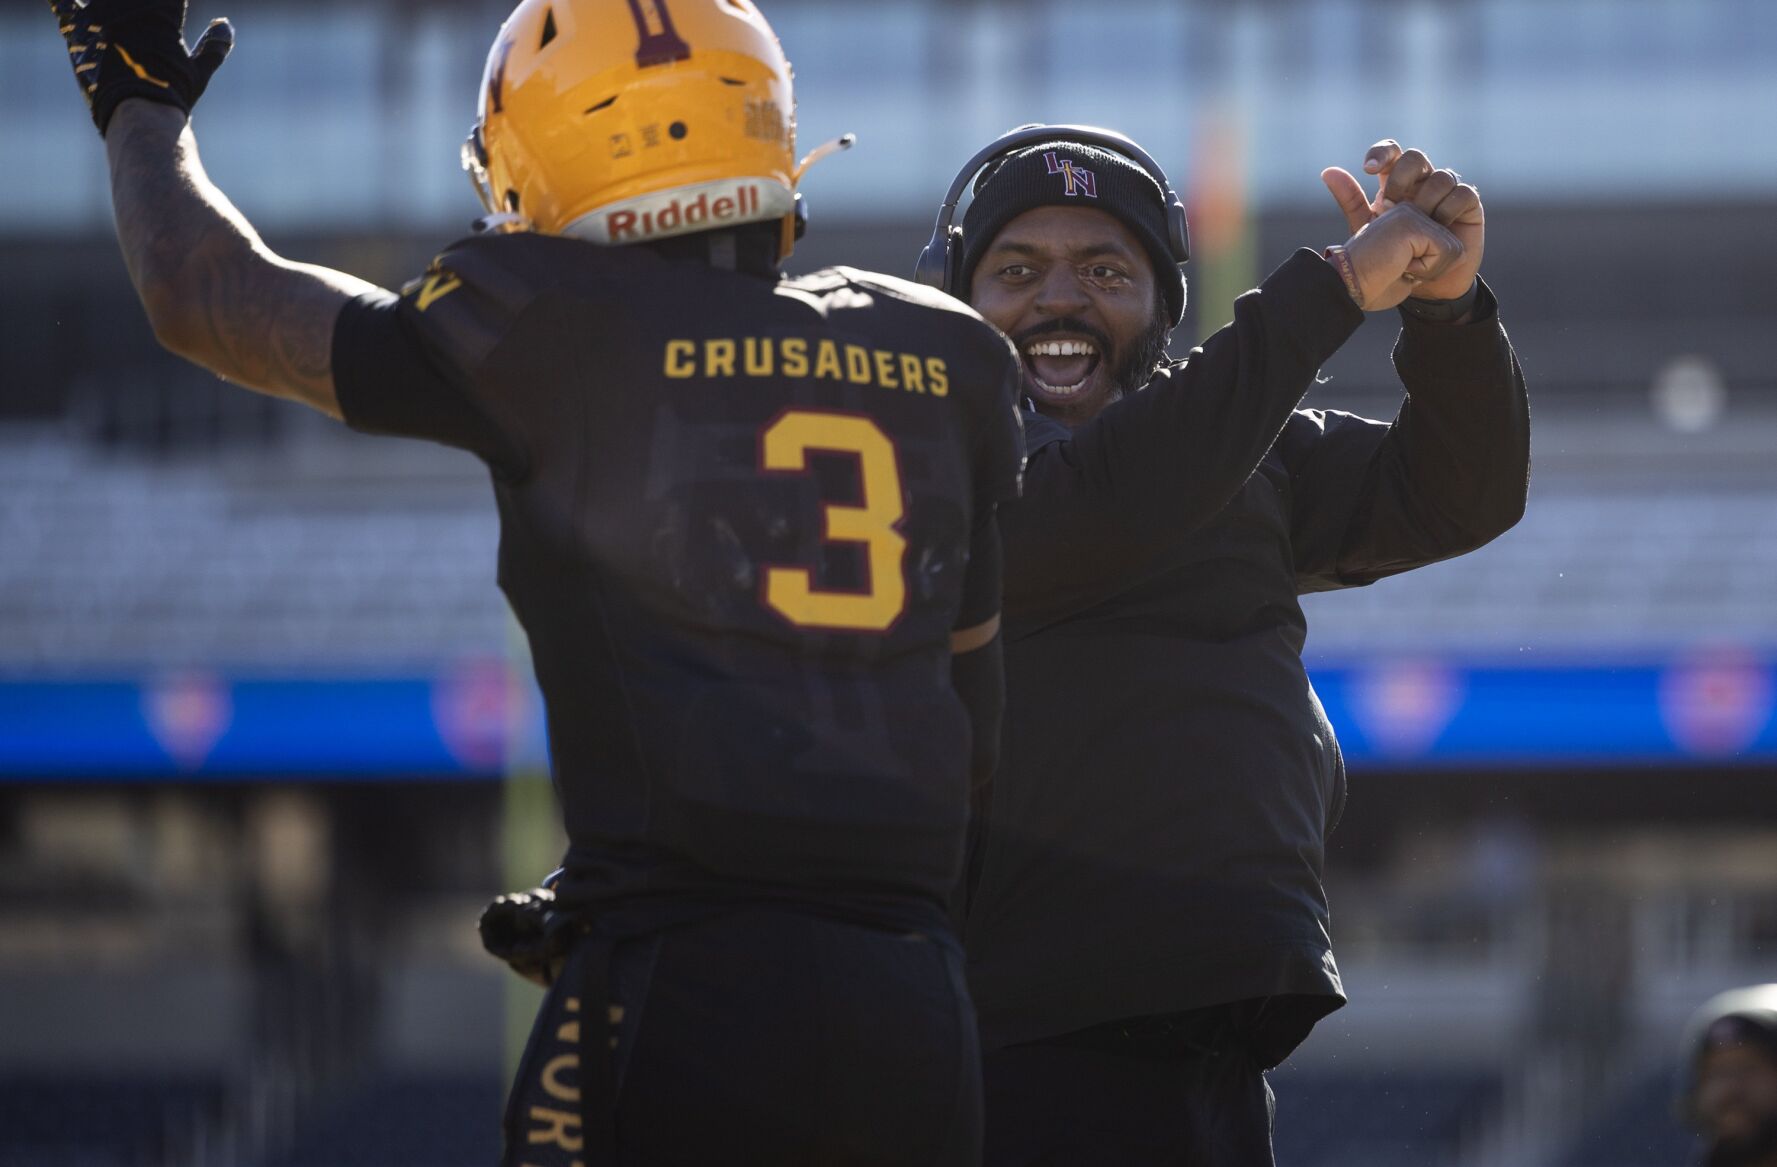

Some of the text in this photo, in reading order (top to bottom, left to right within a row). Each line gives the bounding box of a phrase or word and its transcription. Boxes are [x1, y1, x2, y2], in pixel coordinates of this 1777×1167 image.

[606, 185, 759, 242] Riddell
[664, 337, 949, 397] CRUSADERS
[758, 406, 907, 635] 3
